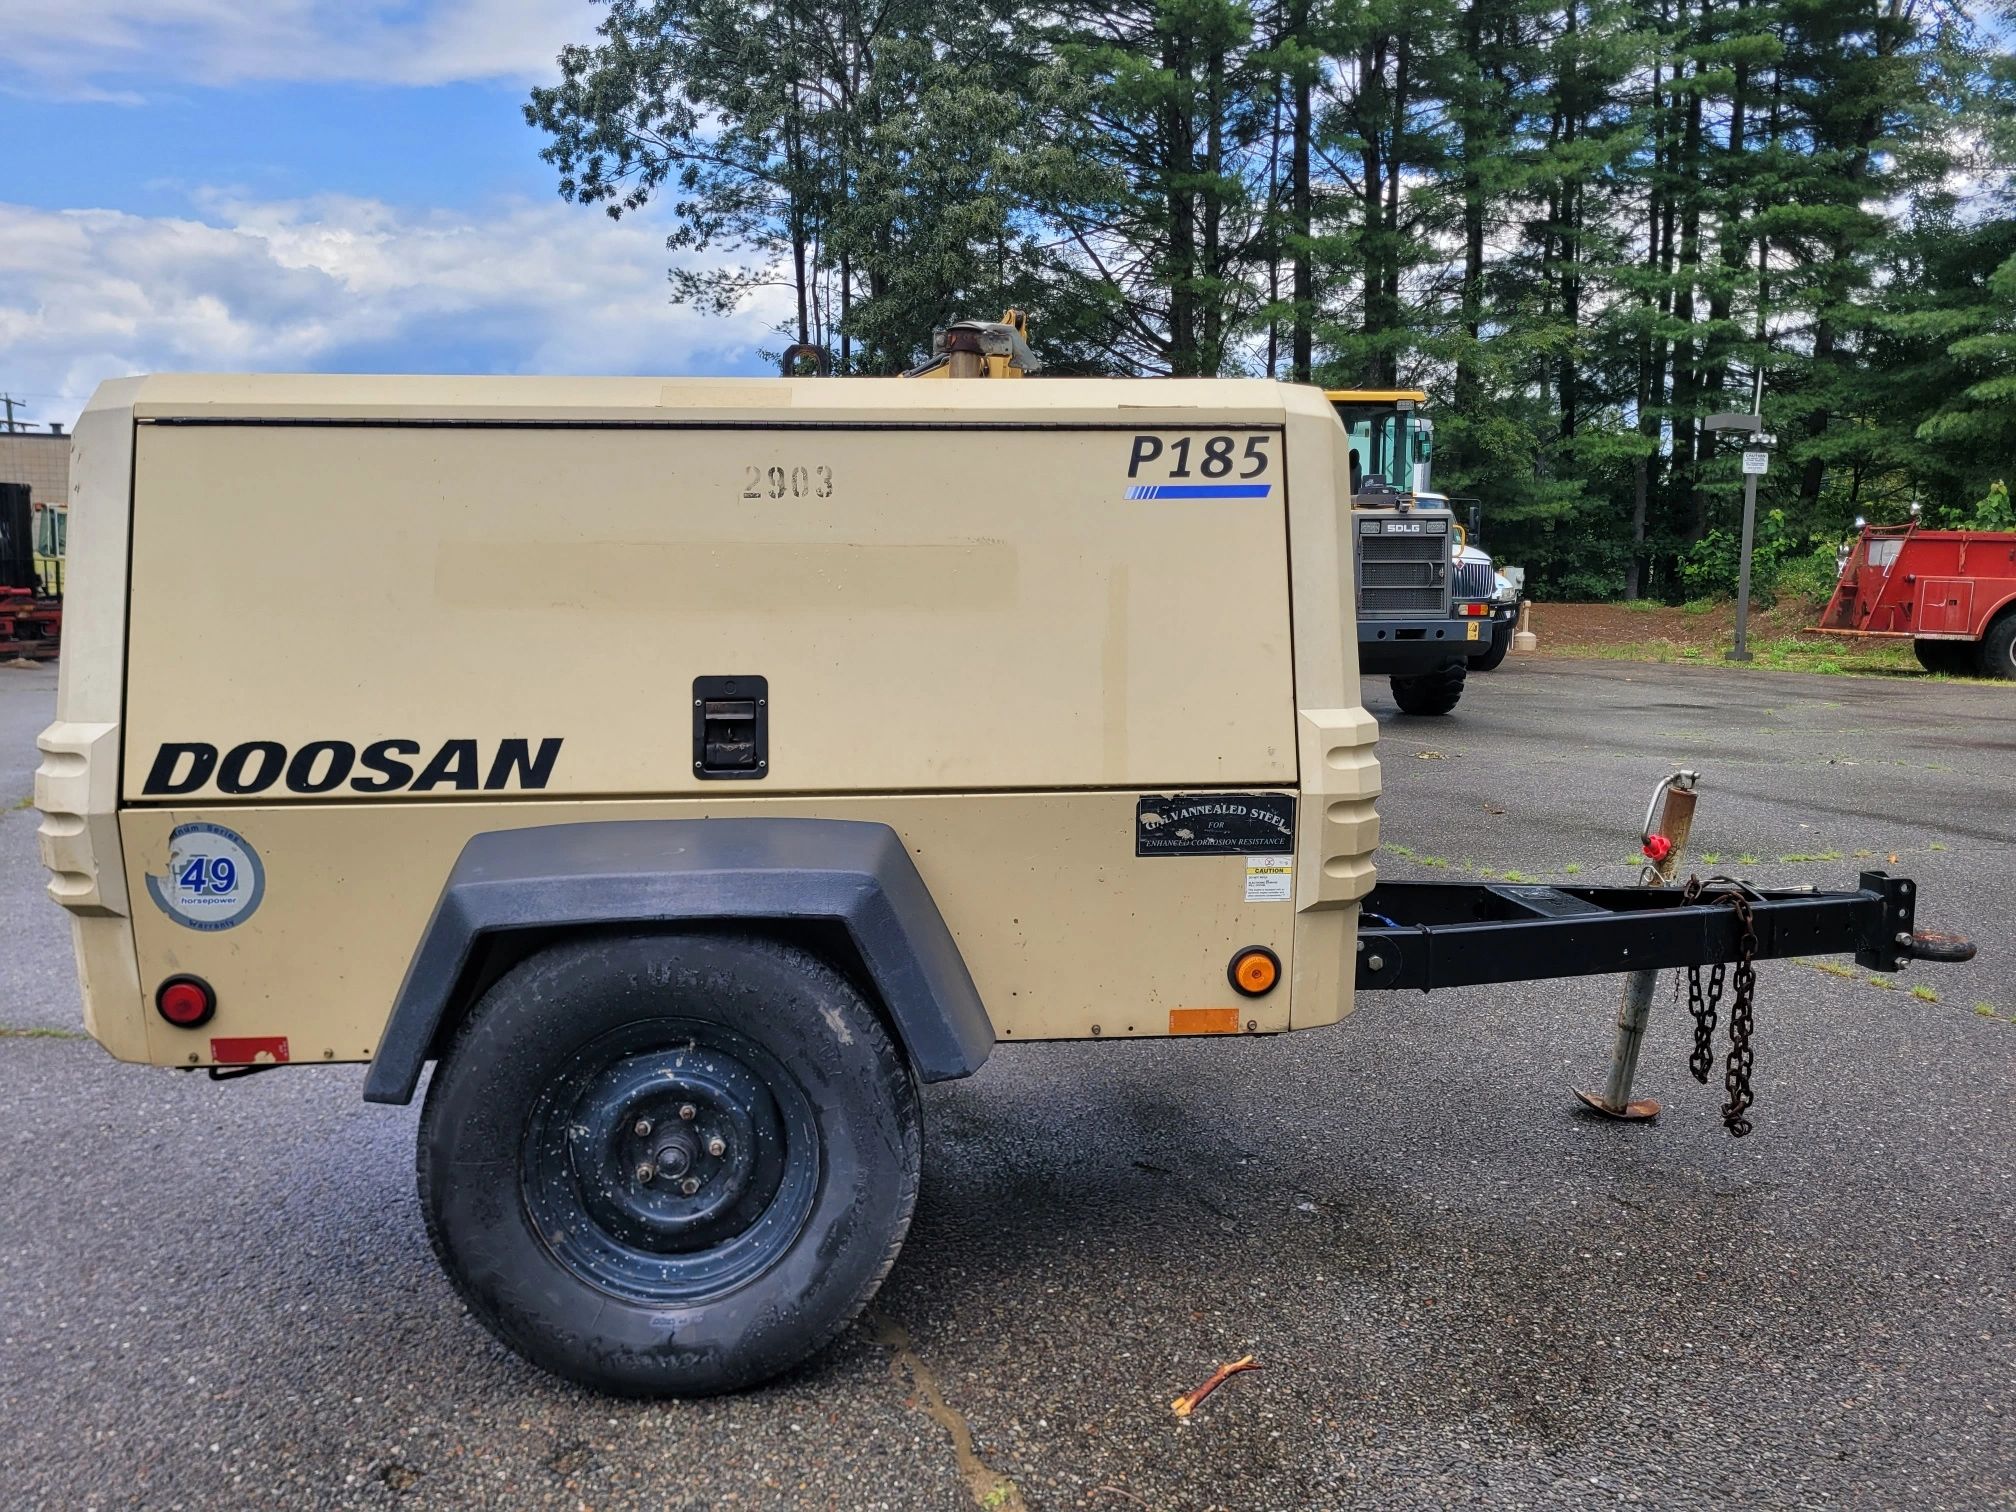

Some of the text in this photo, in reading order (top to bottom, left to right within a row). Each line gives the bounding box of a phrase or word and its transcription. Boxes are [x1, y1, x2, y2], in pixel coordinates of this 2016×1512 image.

[1127, 435, 1270, 479] P185
[743, 465, 833, 499] 2903
[1387, 524, 1420, 533] SDLG
[142, 737, 564, 795] DOOSAN
[1208, 821, 1225, 829] FOR
[1249, 808, 1287, 828] STEEL
[1146, 837, 1285, 847] ENHANCED CORROSION RESISTANCE
[180, 857, 236, 893] 49
[181, 897, 237, 905] horsepower
[188, 919, 235, 929] Warranty
